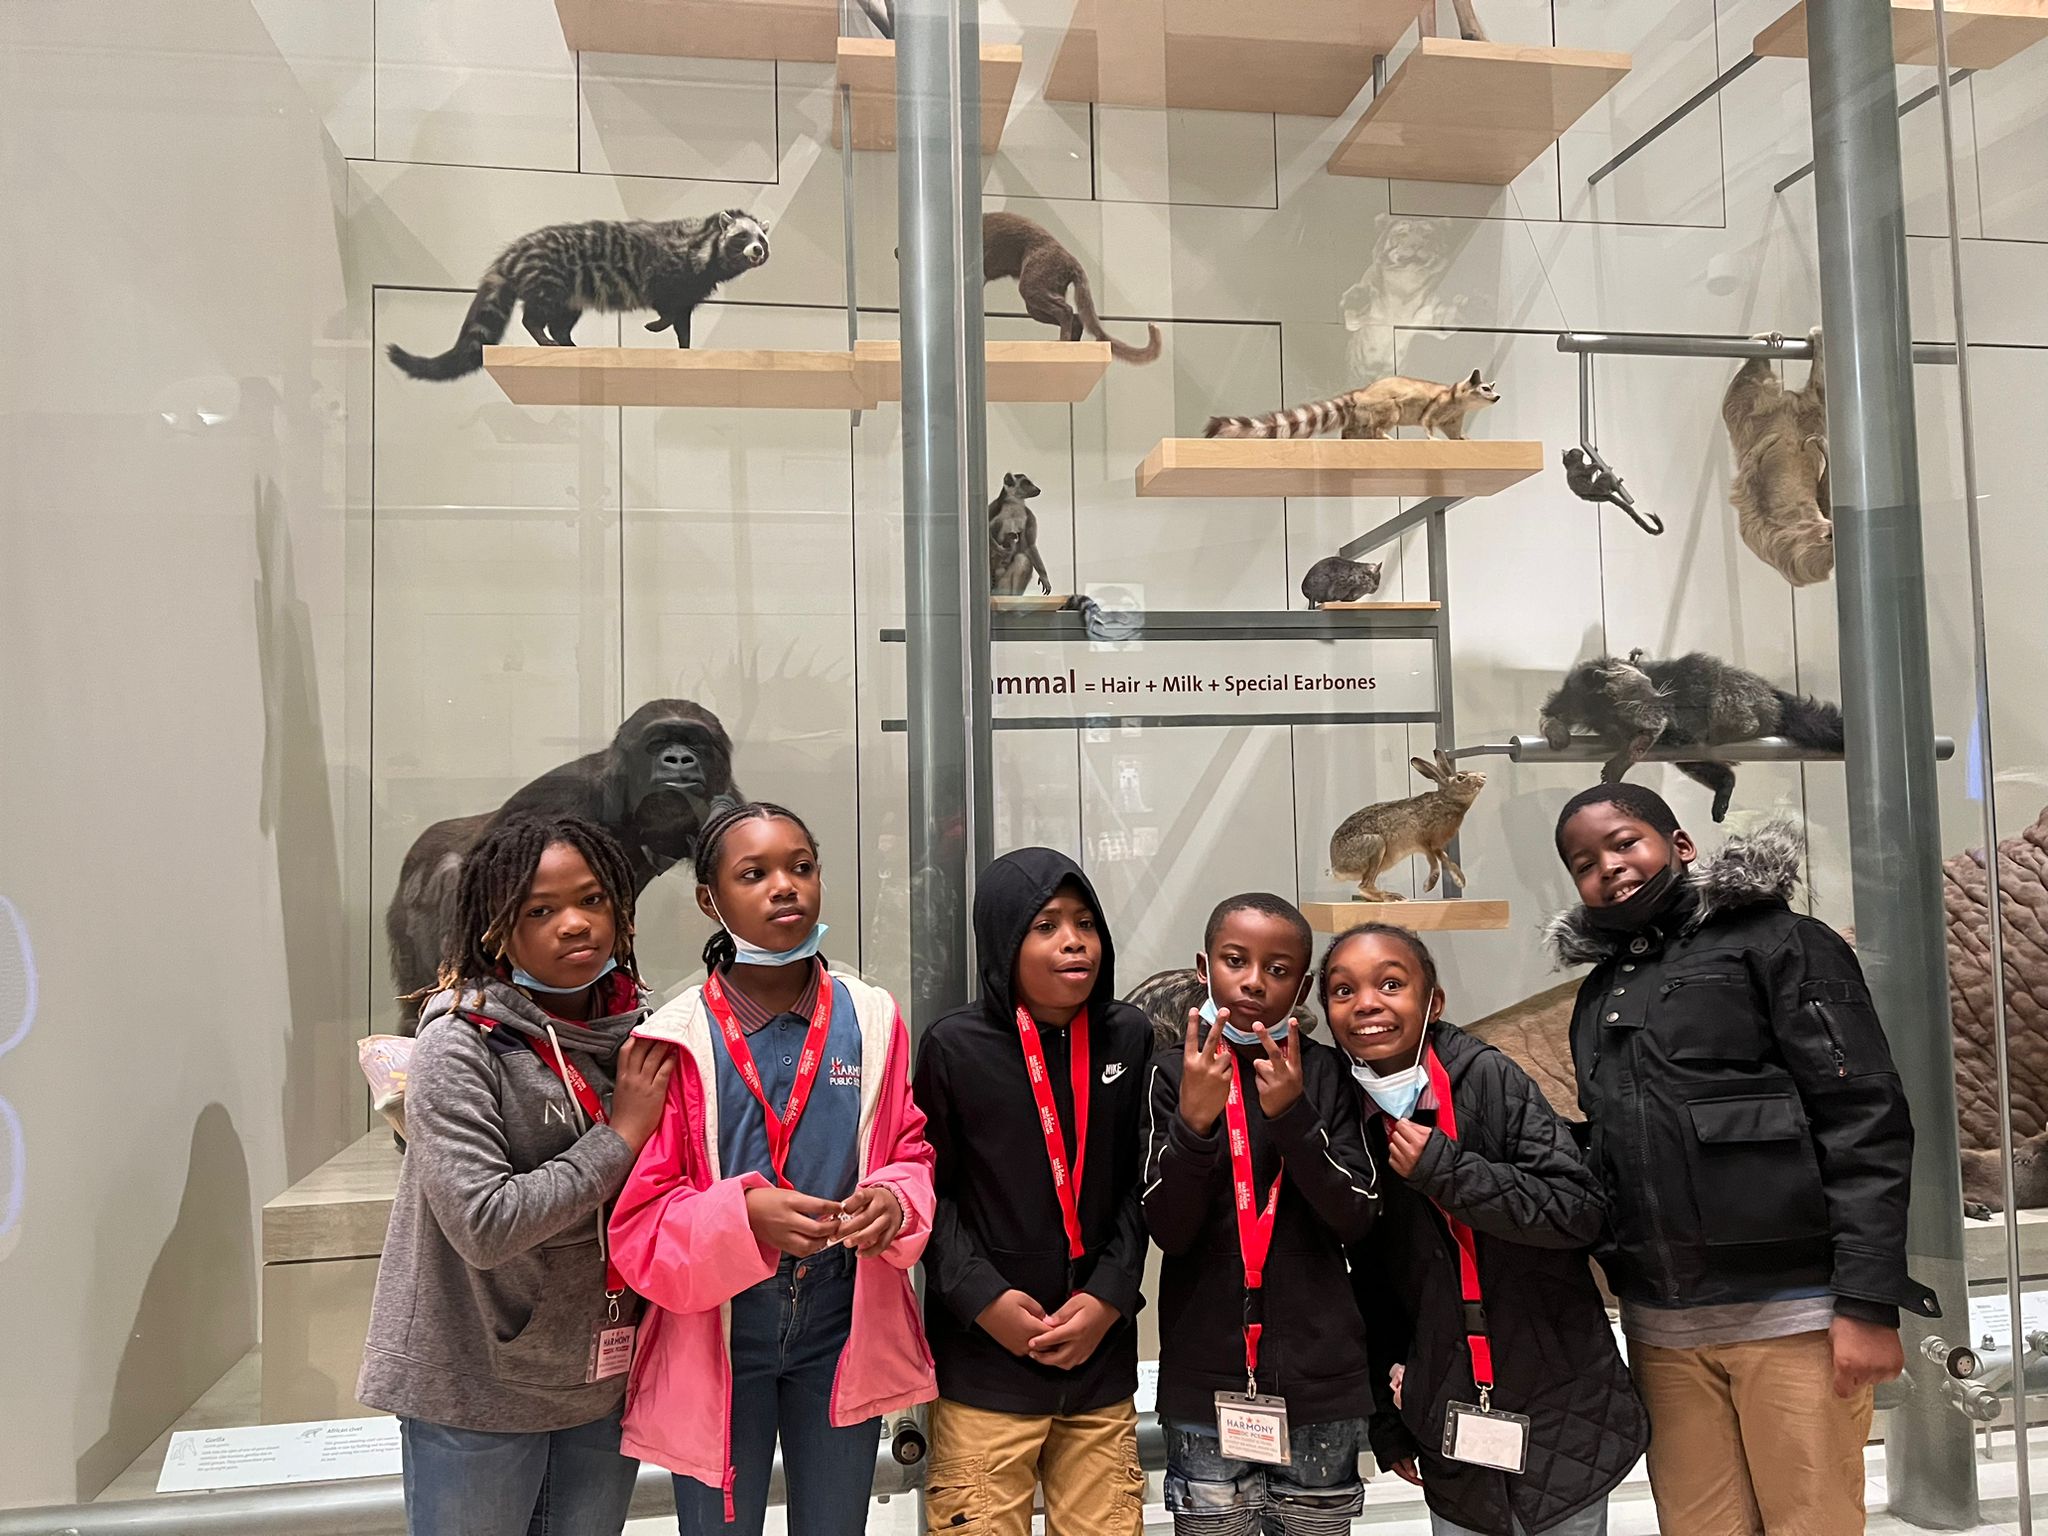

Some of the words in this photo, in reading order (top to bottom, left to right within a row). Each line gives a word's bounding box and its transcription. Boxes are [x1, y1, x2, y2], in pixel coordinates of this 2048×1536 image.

[991, 669, 1075, 694] mmal
[1101, 676, 1141, 693] Hair
[1162, 675, 1203, 693] Milk
[1224, 674, 1288, 696] Special
[1294, 674, 1376, 691] Earbones
[1105, 1062, 1122, 1075] NIKE
[829, 1077, 853, 1086] PUBLIC
[1226, 1419, 1274, 1434] HARMONY
